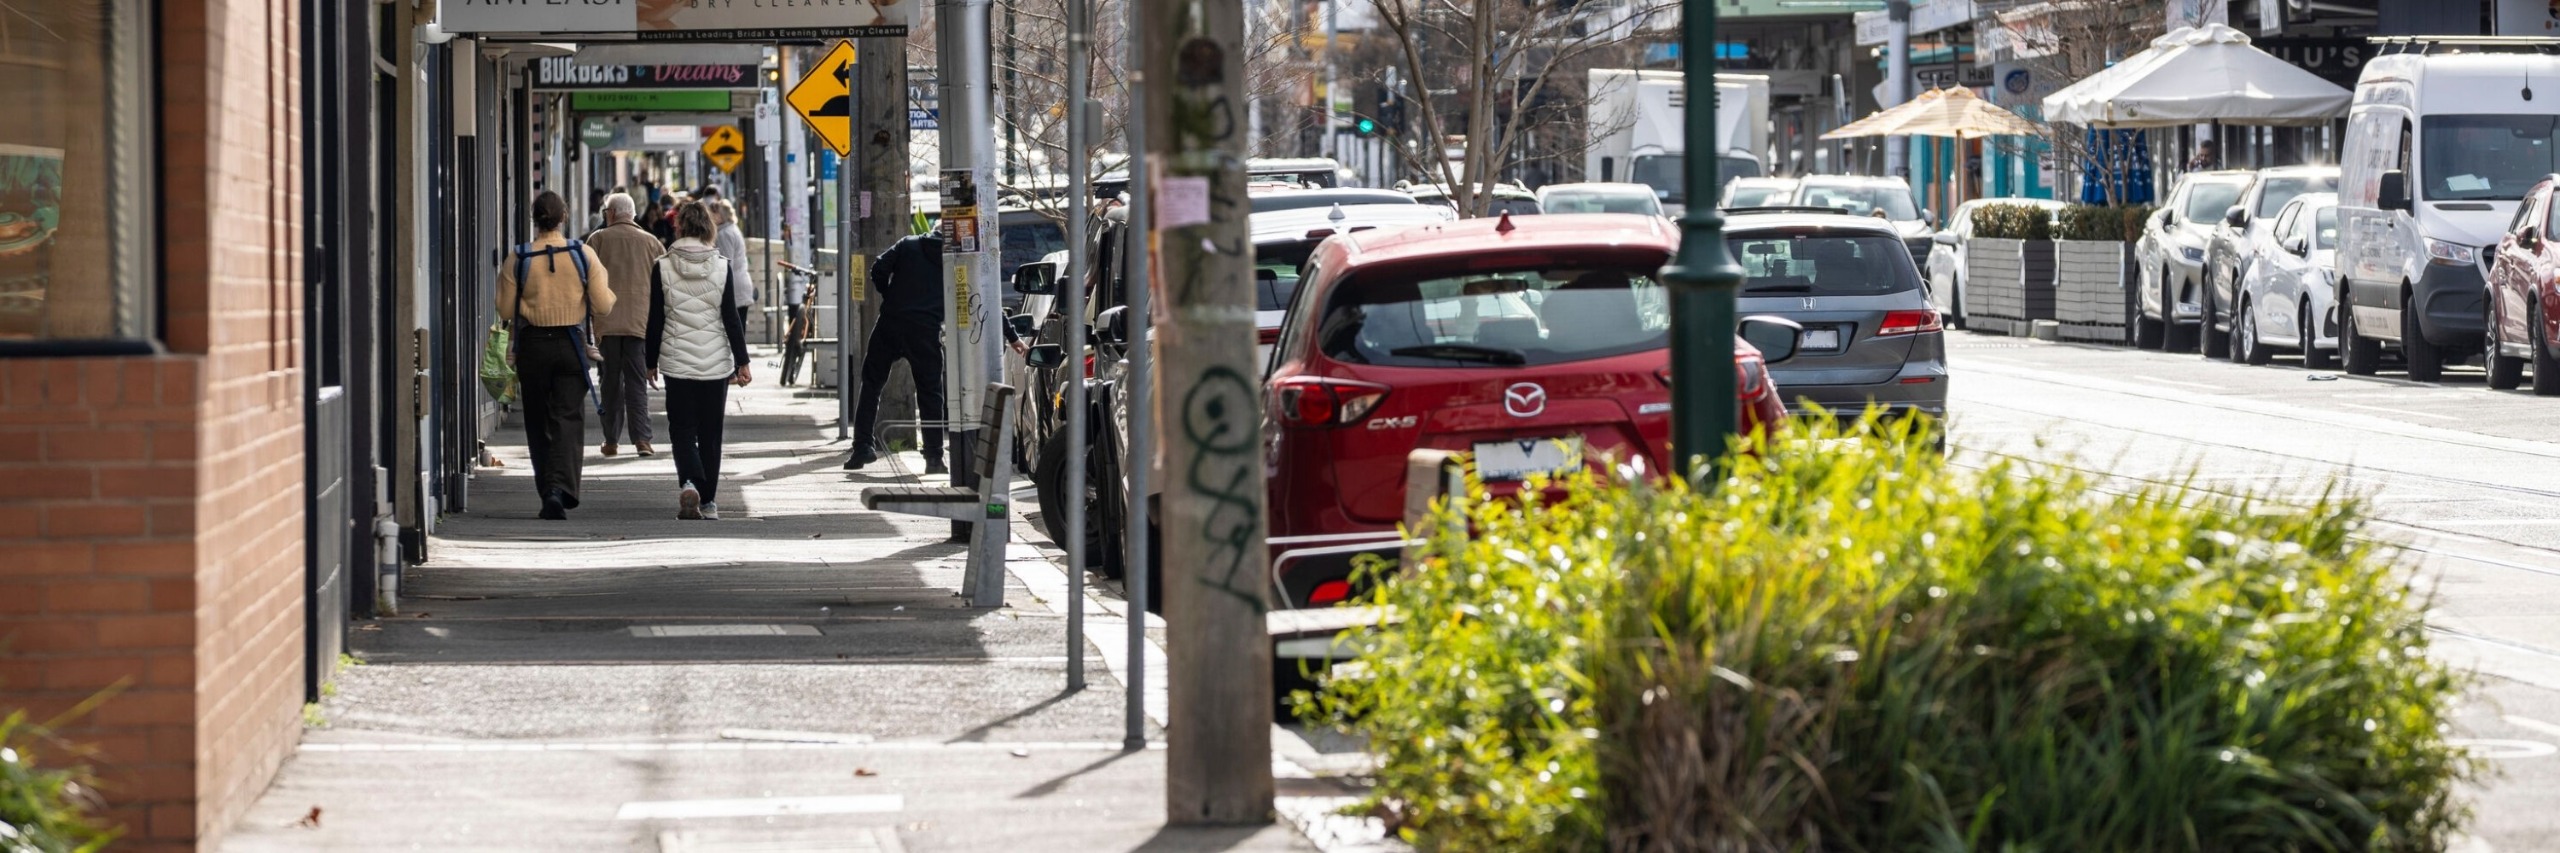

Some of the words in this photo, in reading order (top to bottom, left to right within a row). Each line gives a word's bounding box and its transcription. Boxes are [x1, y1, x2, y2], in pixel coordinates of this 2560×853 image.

[641, 31, 693, 39] Australia's
[696, 30, 733, 39] Leading
[737, 30, 766, 38] Bridal
[779, 29, 817, 38] Evening
[821, 28, 845, 36] Wear
[848, 27, 865, 36] Dry
[868, 26, 906, 35] Cleaner
[2270, 46, 2360, 68] LU'S
[1367, 416, 1418, 430] CX-5
